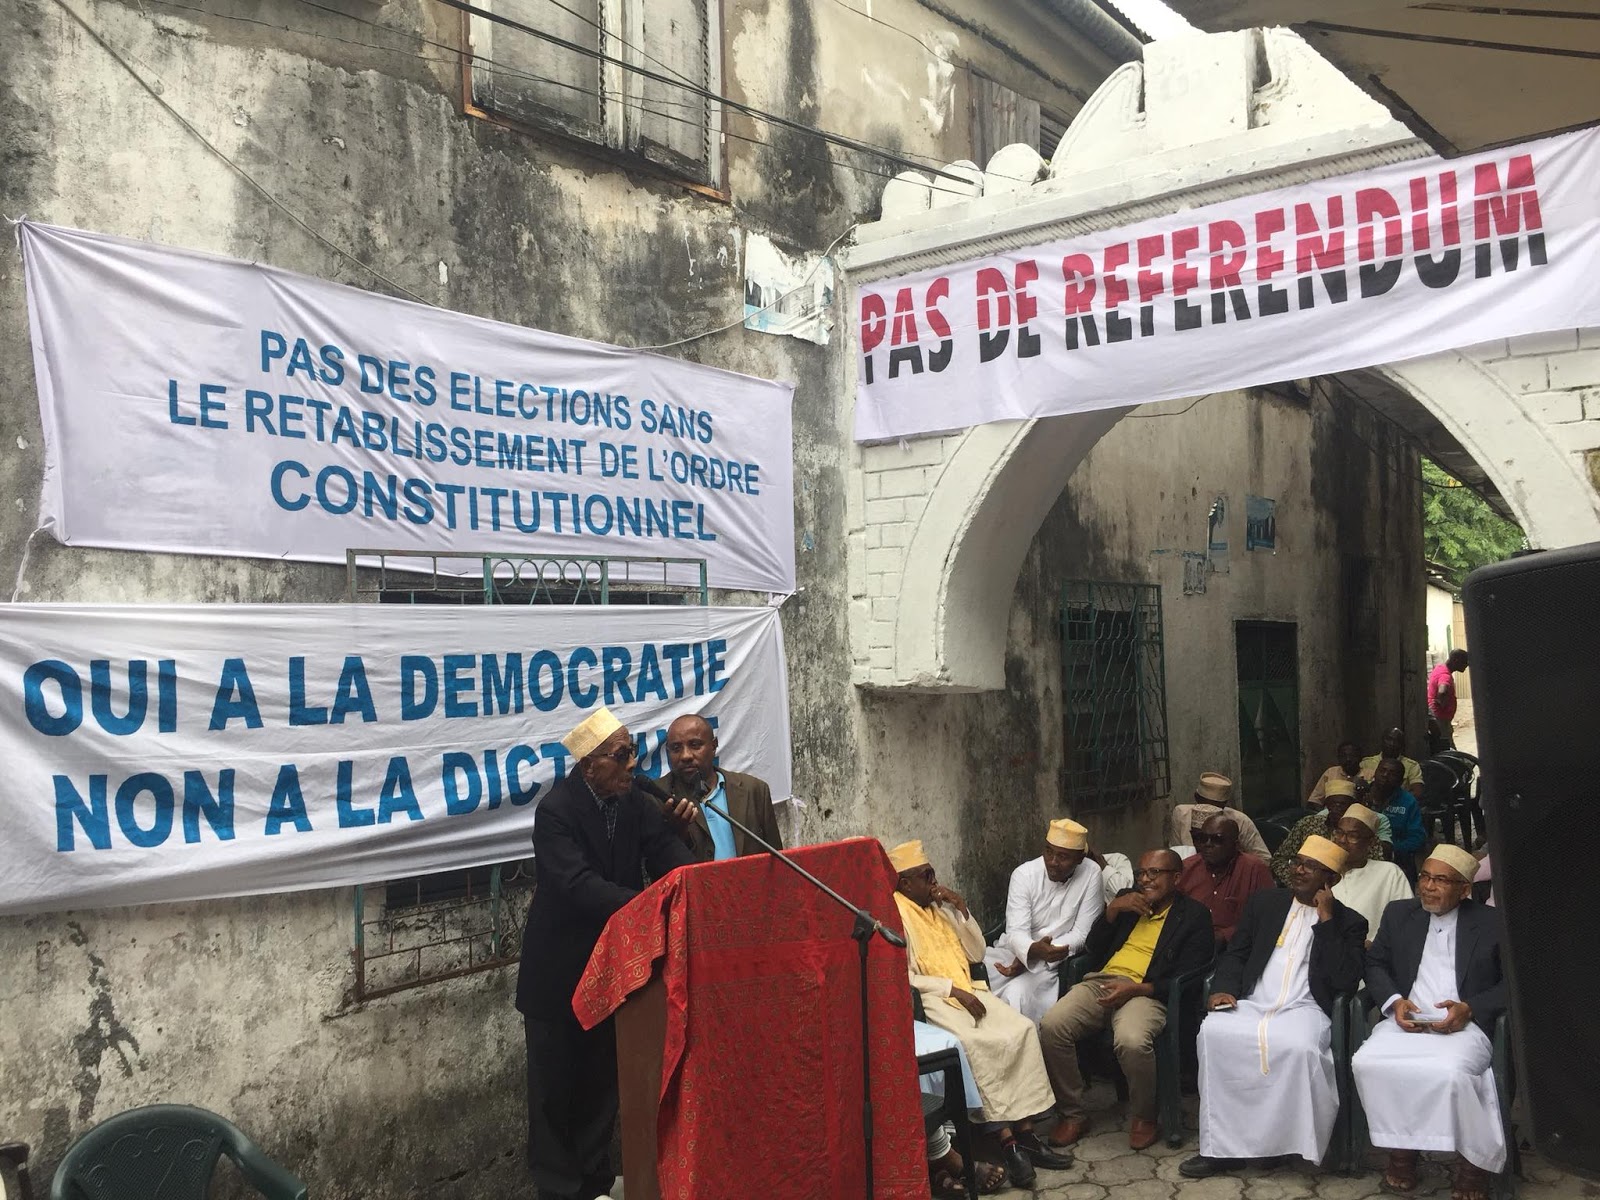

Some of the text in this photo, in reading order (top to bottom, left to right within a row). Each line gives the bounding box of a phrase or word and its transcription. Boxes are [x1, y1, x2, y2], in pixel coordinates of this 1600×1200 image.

[861, 153, 1549, 385] PAS DE REFERENDUM
[168, 379, 760, 496] LE RETABLISSEMENT DE L'ORDRE
[261, 330, 713, 444] PAS DES ELECTIONS SANS
[270, 460, 717, 541] CONSTITUTIONNEL
[23, 639, 730, 736] OUI A LA DEMOCRATIE
[53, 716, 720, 852] NON A LA DICTU
